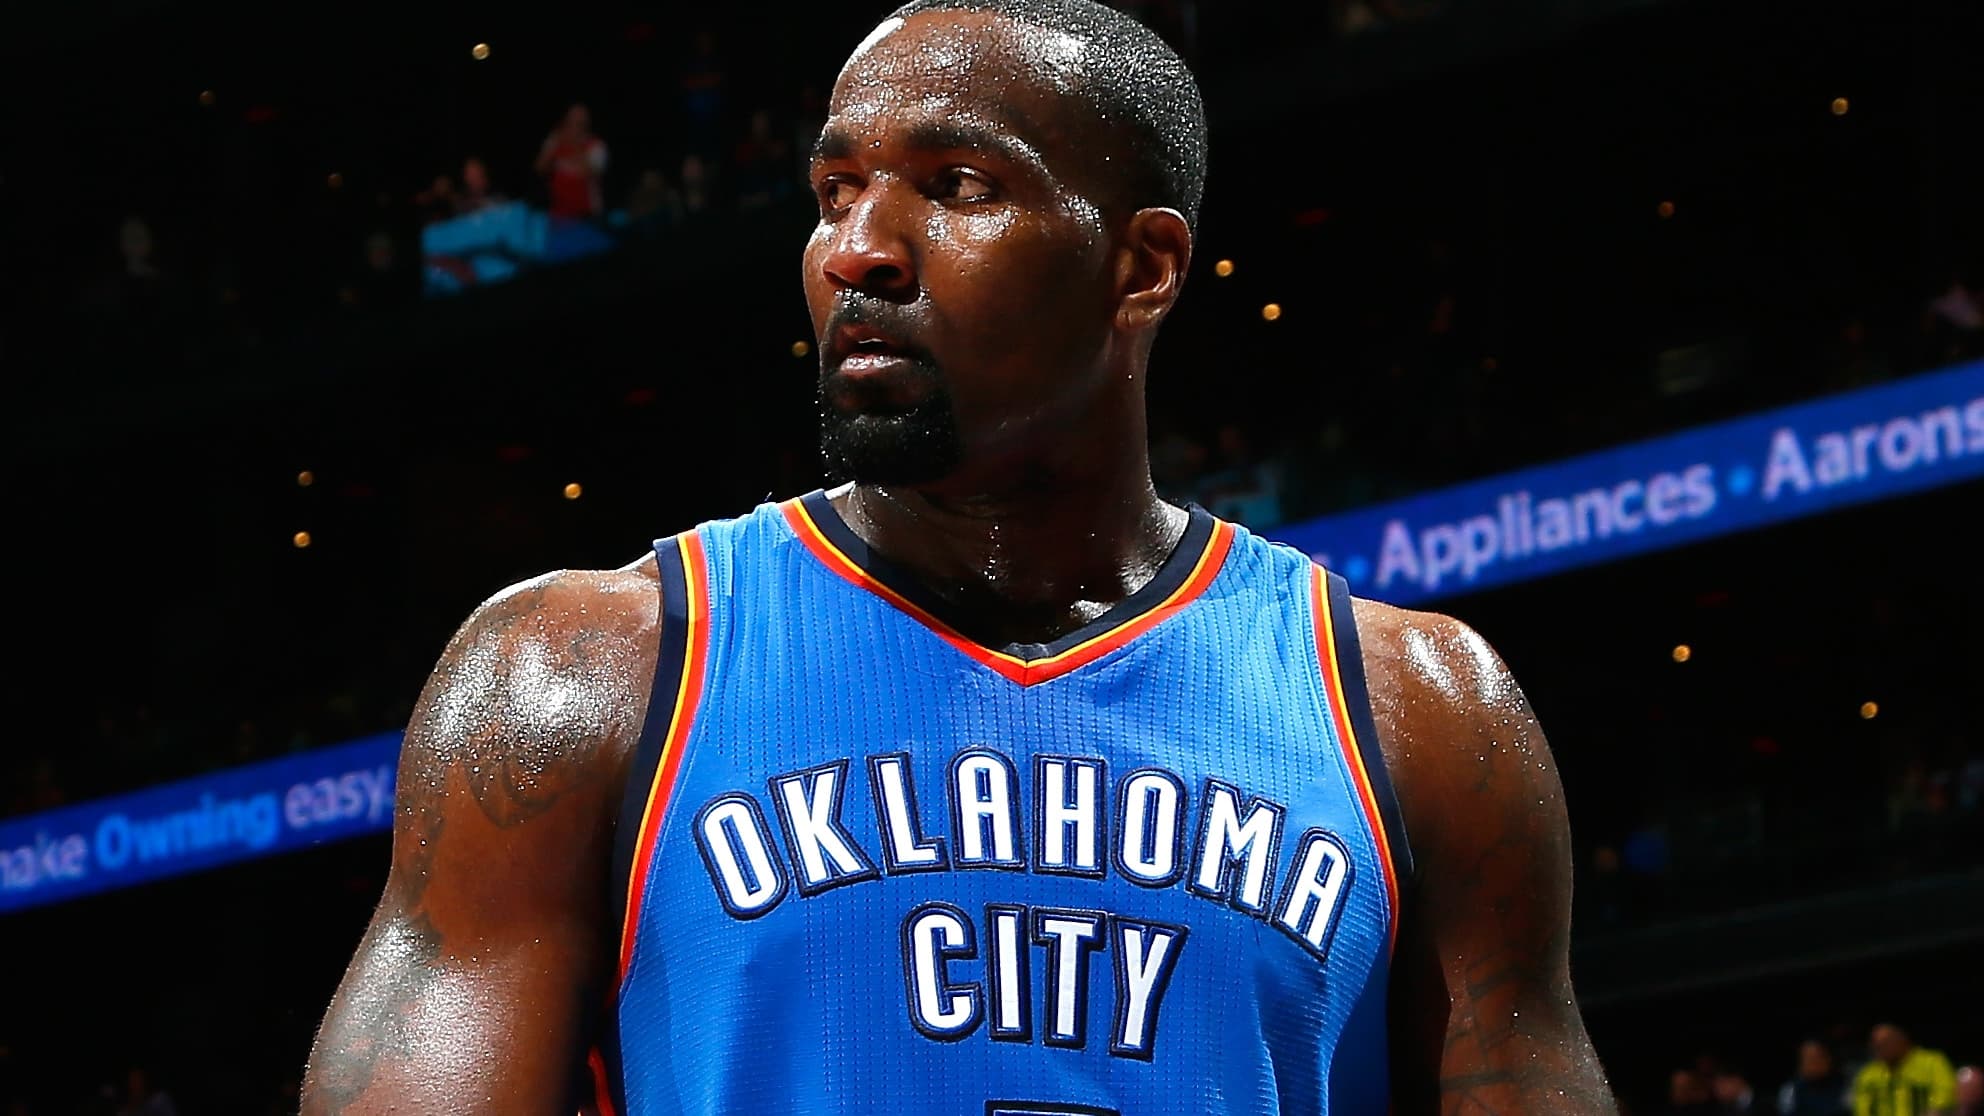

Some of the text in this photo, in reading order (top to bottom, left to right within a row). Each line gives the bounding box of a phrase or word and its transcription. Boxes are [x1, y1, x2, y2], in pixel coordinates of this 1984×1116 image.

[1373, 396, 1984, 590] Appliances Aarons
[95, 793, 278, 869] Owning
[692, 746, 1355, 961] OKLAHOMA
[901, 902, 1189, 1062] CITY
